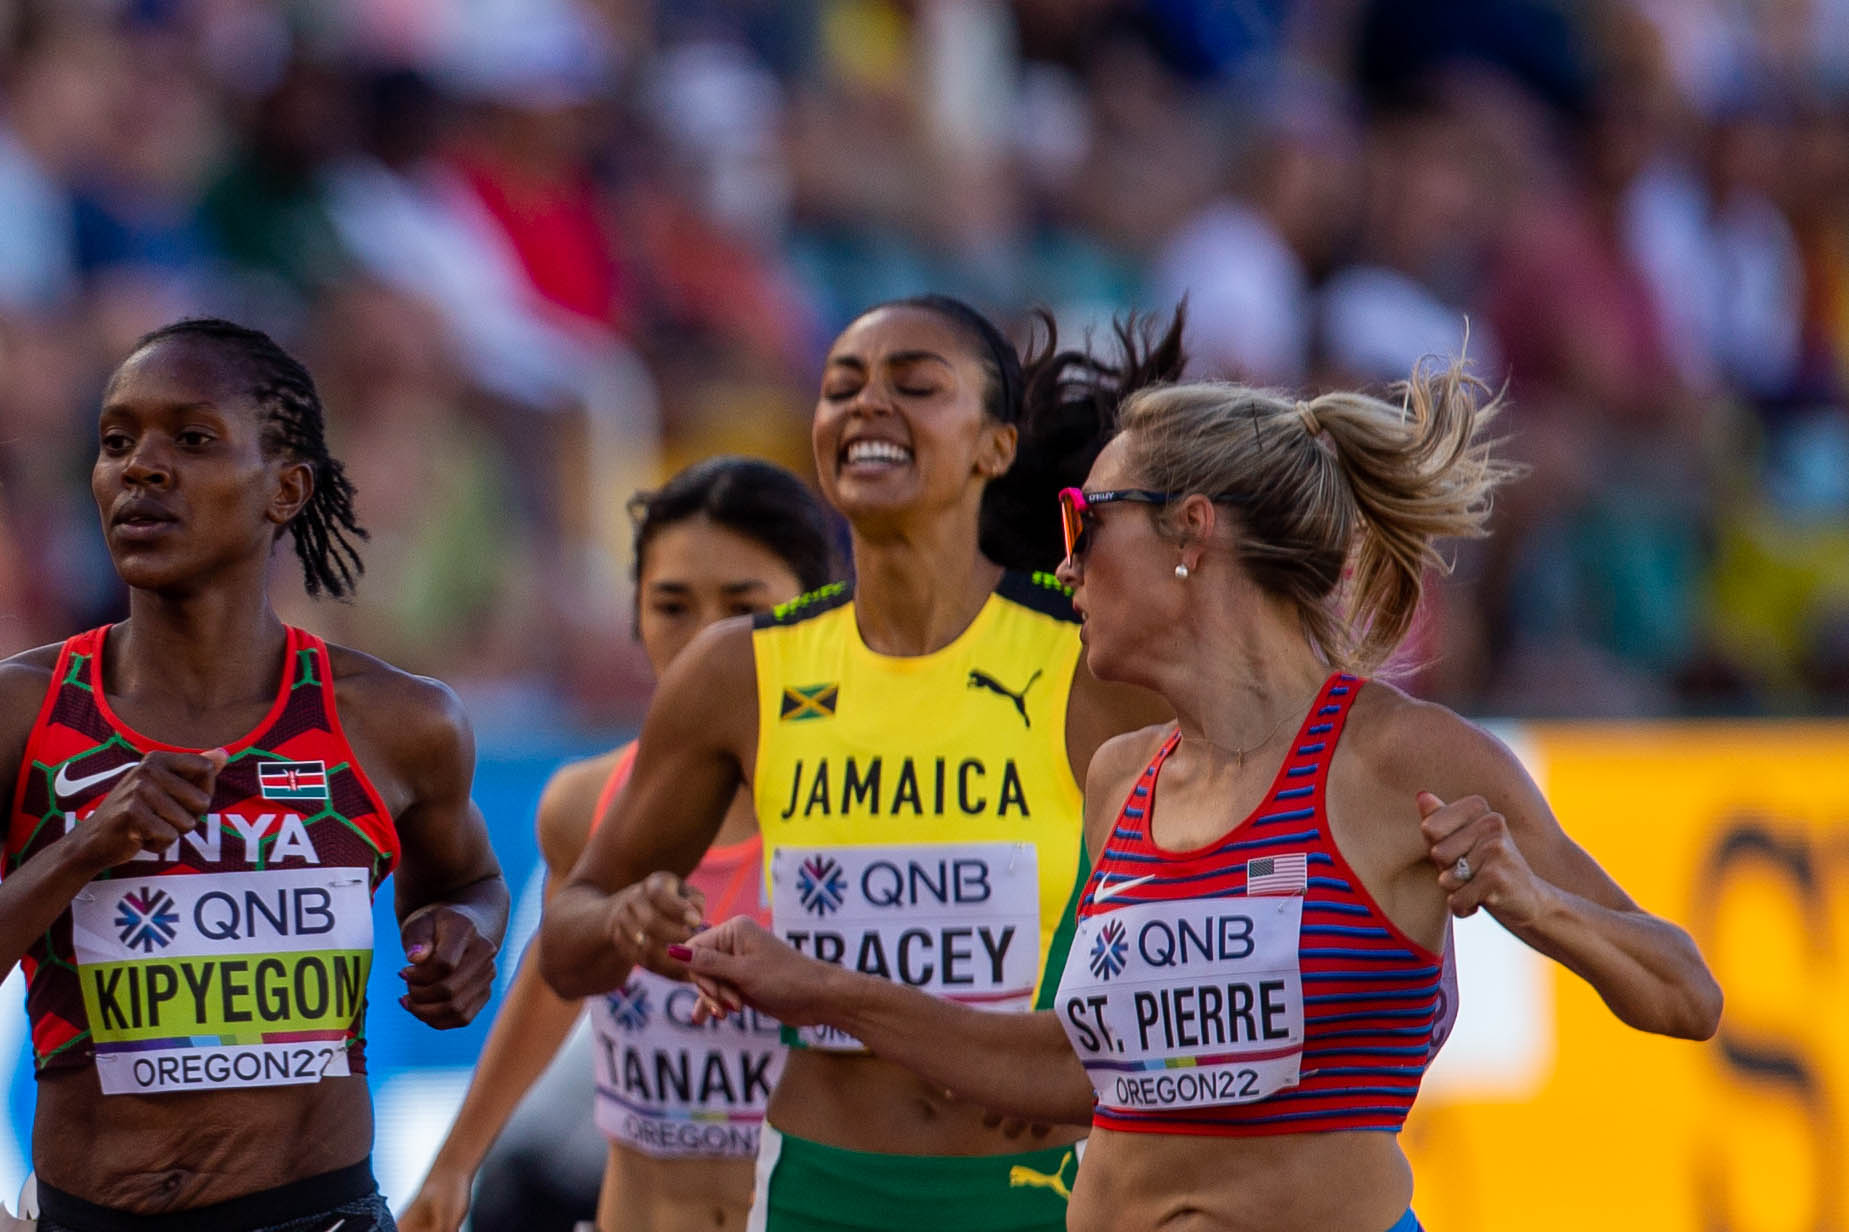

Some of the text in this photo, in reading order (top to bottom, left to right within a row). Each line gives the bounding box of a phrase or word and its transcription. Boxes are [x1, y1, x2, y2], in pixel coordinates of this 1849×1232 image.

[781, 756, 1032, 820] JAMAICA
[64, 811, 320, 865] NYA
[860, 858, 993, 908] QNB
[192, 886, 336, 941] QNB
[1137, 914, 1255, 968] QNB
[93, 954, 362, 1032] KIPYEGON
[1066, 979, 1290, 1053] ST. PIERRE
[133, 1048, 334, 1088] OREGON22
[602, 1034, 772, 1104] TANAK
[1115, 1069, 1261, 1106] OREGON22
[626, 1114, 764, 1152] OREGON
